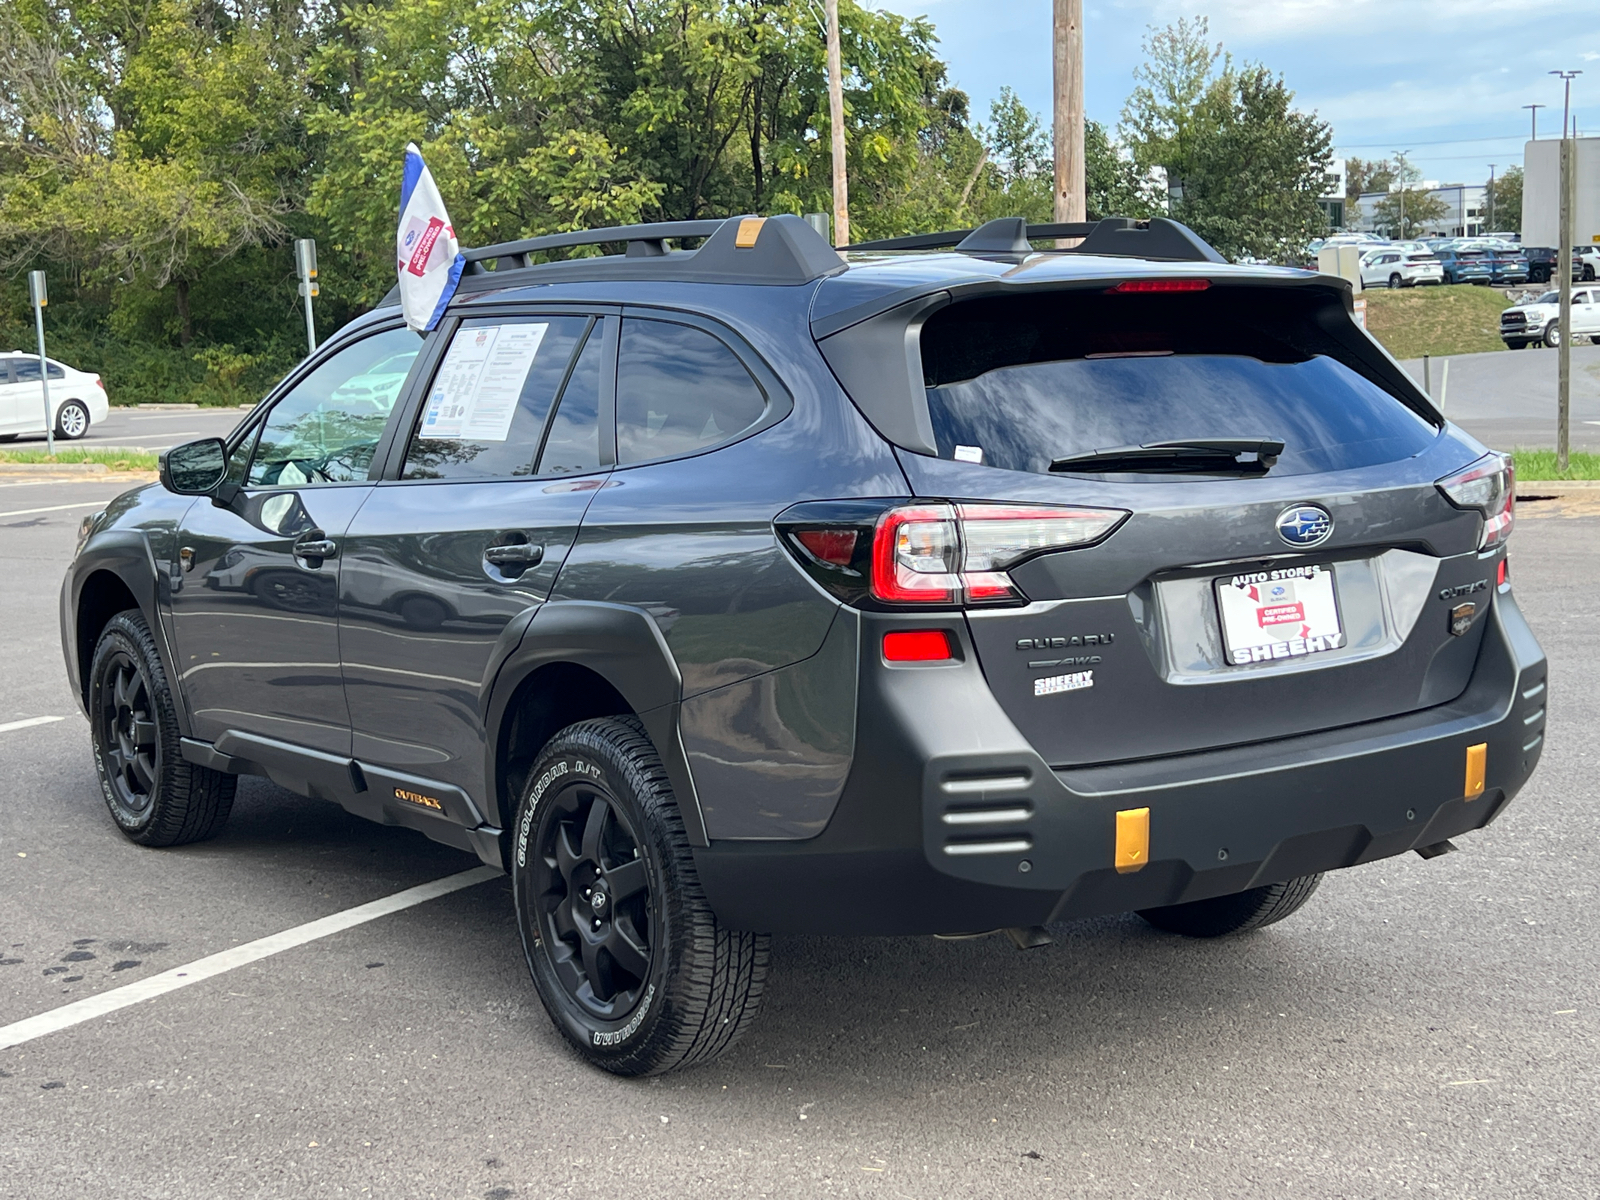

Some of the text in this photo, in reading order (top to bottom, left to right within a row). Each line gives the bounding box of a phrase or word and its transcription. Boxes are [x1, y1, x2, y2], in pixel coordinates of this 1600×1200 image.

[412, 227, 434, 264] CERTIFIED
[415, 226, 441, 271] PRE-OWNED
[1231, 565, 1321, 587] AUTO STORES
[1262, 613, 1301, 623] PRE-OWNED
[1264, 606, 1297, 616] CERTIFIED
[1016, 633, 1115, 650] SUBARU
[1233, 633, 1342, 665] SHEEHY
[1058, 655, 1102, 667] AWD
[1035, 670, 1093, 689] SHEEHY
[395, 788, 442, 810] OUTBACK
[518, 761, 600, 867] GEOLANDAR A/T
